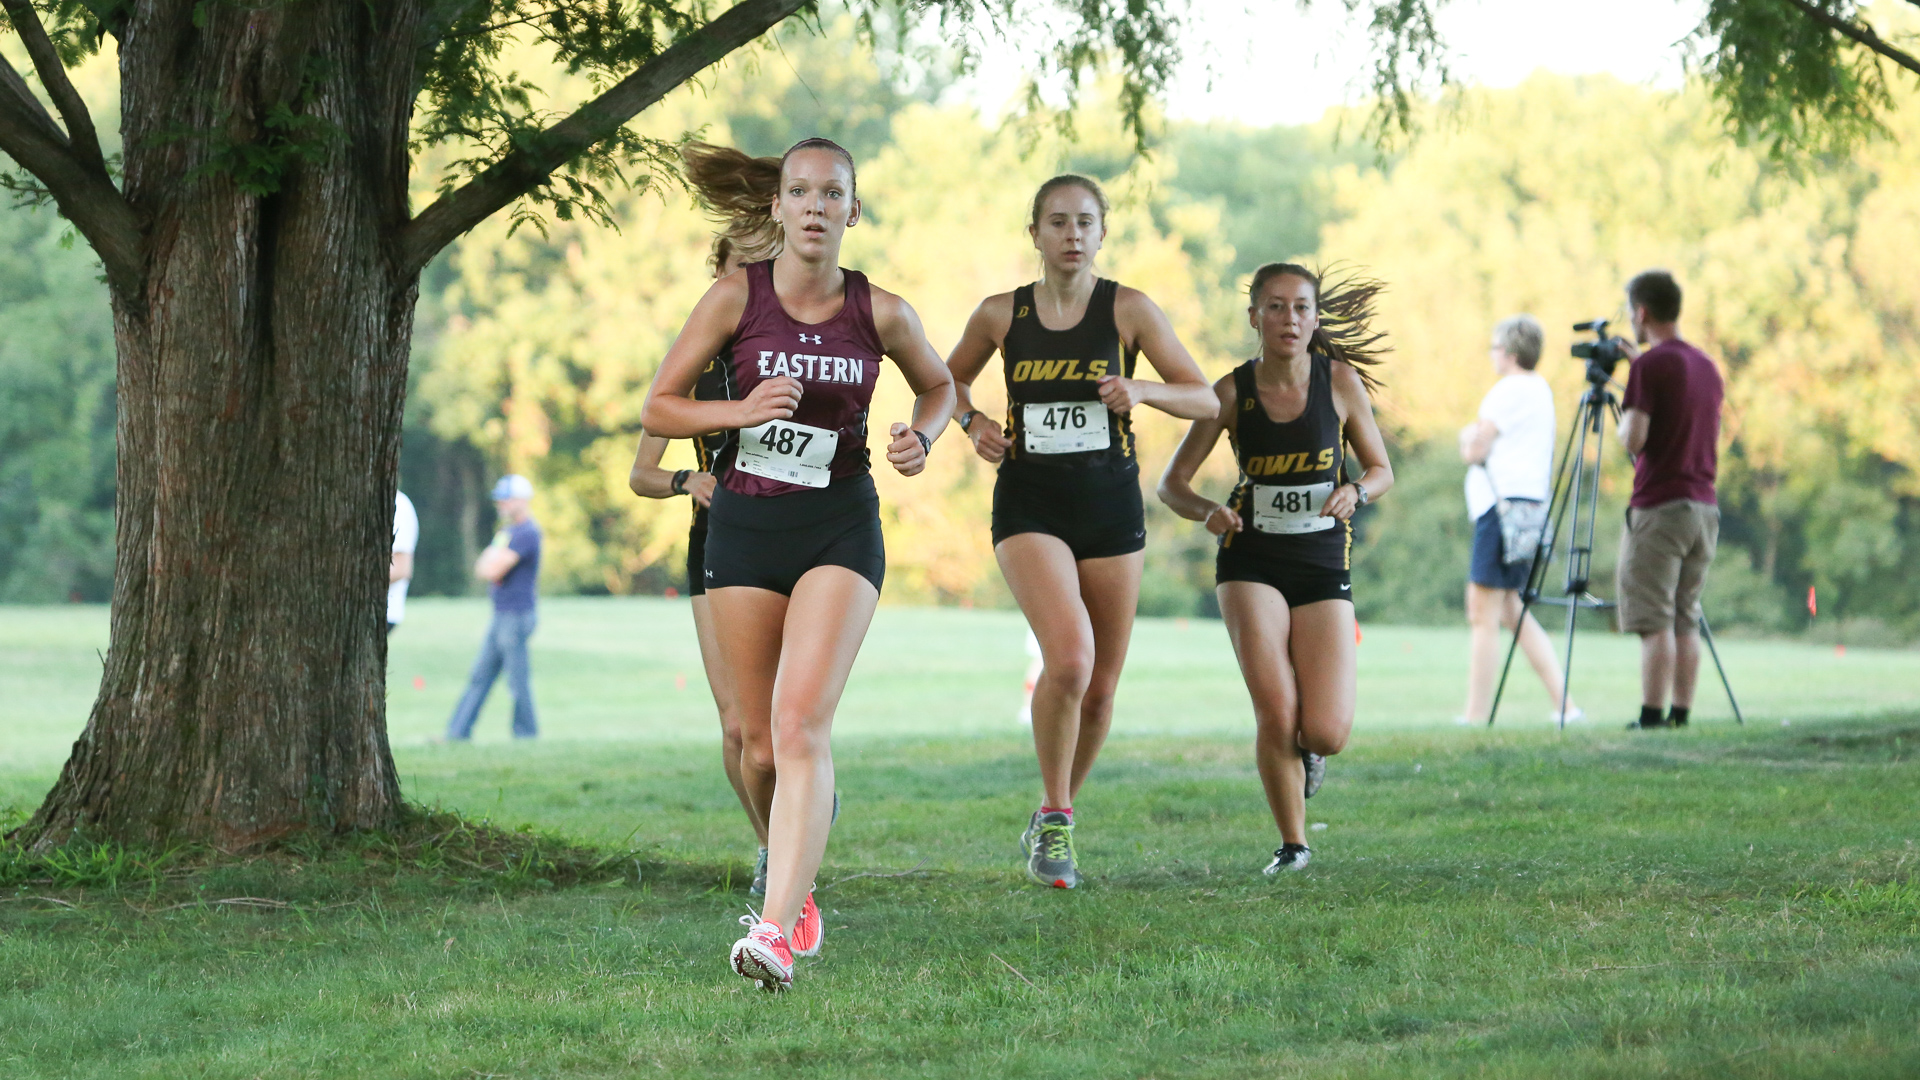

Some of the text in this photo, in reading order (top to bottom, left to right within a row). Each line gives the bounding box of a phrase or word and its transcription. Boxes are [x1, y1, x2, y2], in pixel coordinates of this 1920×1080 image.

[757, 350, 863, 385] EASTERN
[1012, 360, 1109, 383] OWLS
[1043, 406, 1087, 430] 476
[760, 425, 813, 457] 487
[1246, 447, 1334, 476] OWLS
[1271, 490, 1312, 513] 481
